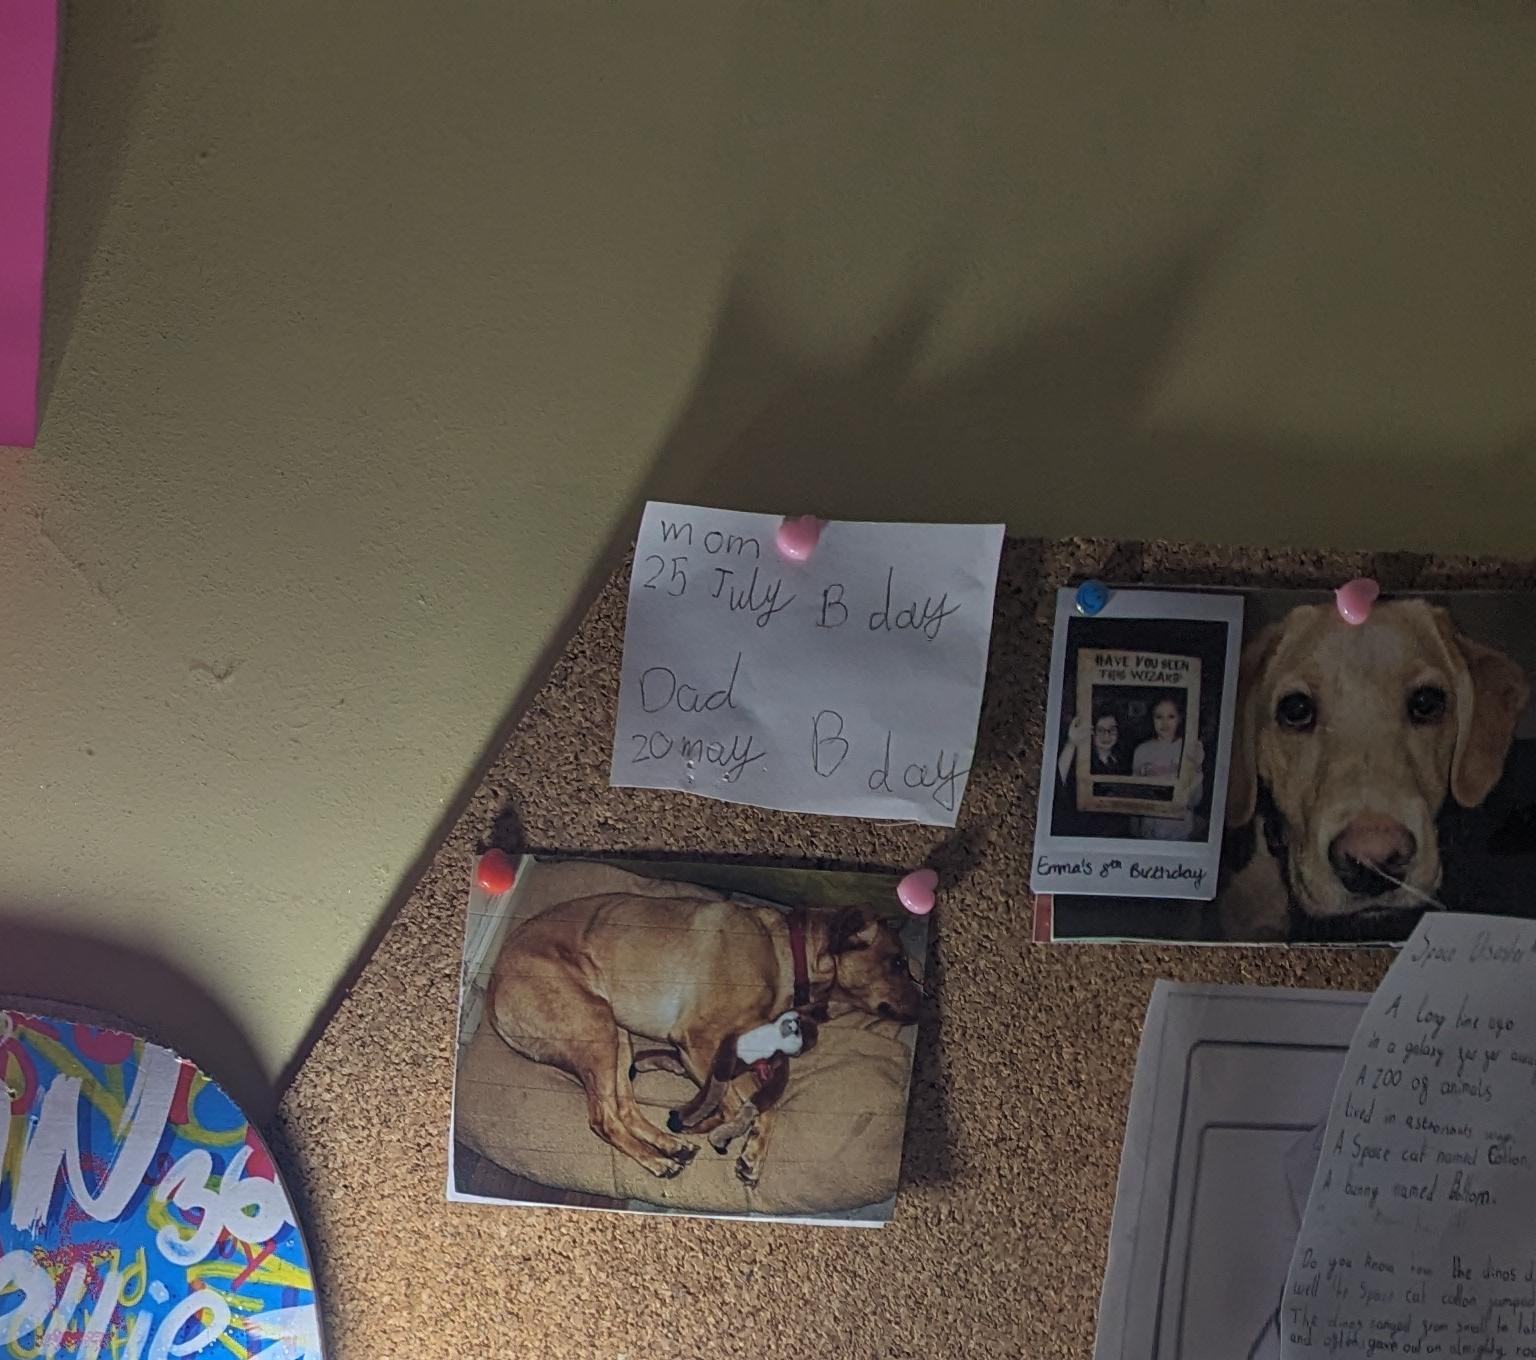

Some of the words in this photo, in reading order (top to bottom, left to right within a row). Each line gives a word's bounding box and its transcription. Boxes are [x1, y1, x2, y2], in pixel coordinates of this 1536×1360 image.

[644, 555, 688, 598] 25
[711, 566, 797, 627] July
[818, 584, 849, 628] B
[869, 566, 962, 640] day
[640, 652, 742, 714] Dad
[1095, 654, 1129, 668] HAVE
[1136, 655, 1159, 670] YOU
[1161, 659, 1189, 672] SEEN
[631, 731, 673, 763] 20
[811, 710, 849, 777] B
[869, 730, 970, 812] day
[1037, 855, 1093, 876] Emma's
[1129, 862, 1207, 890] Birthday
